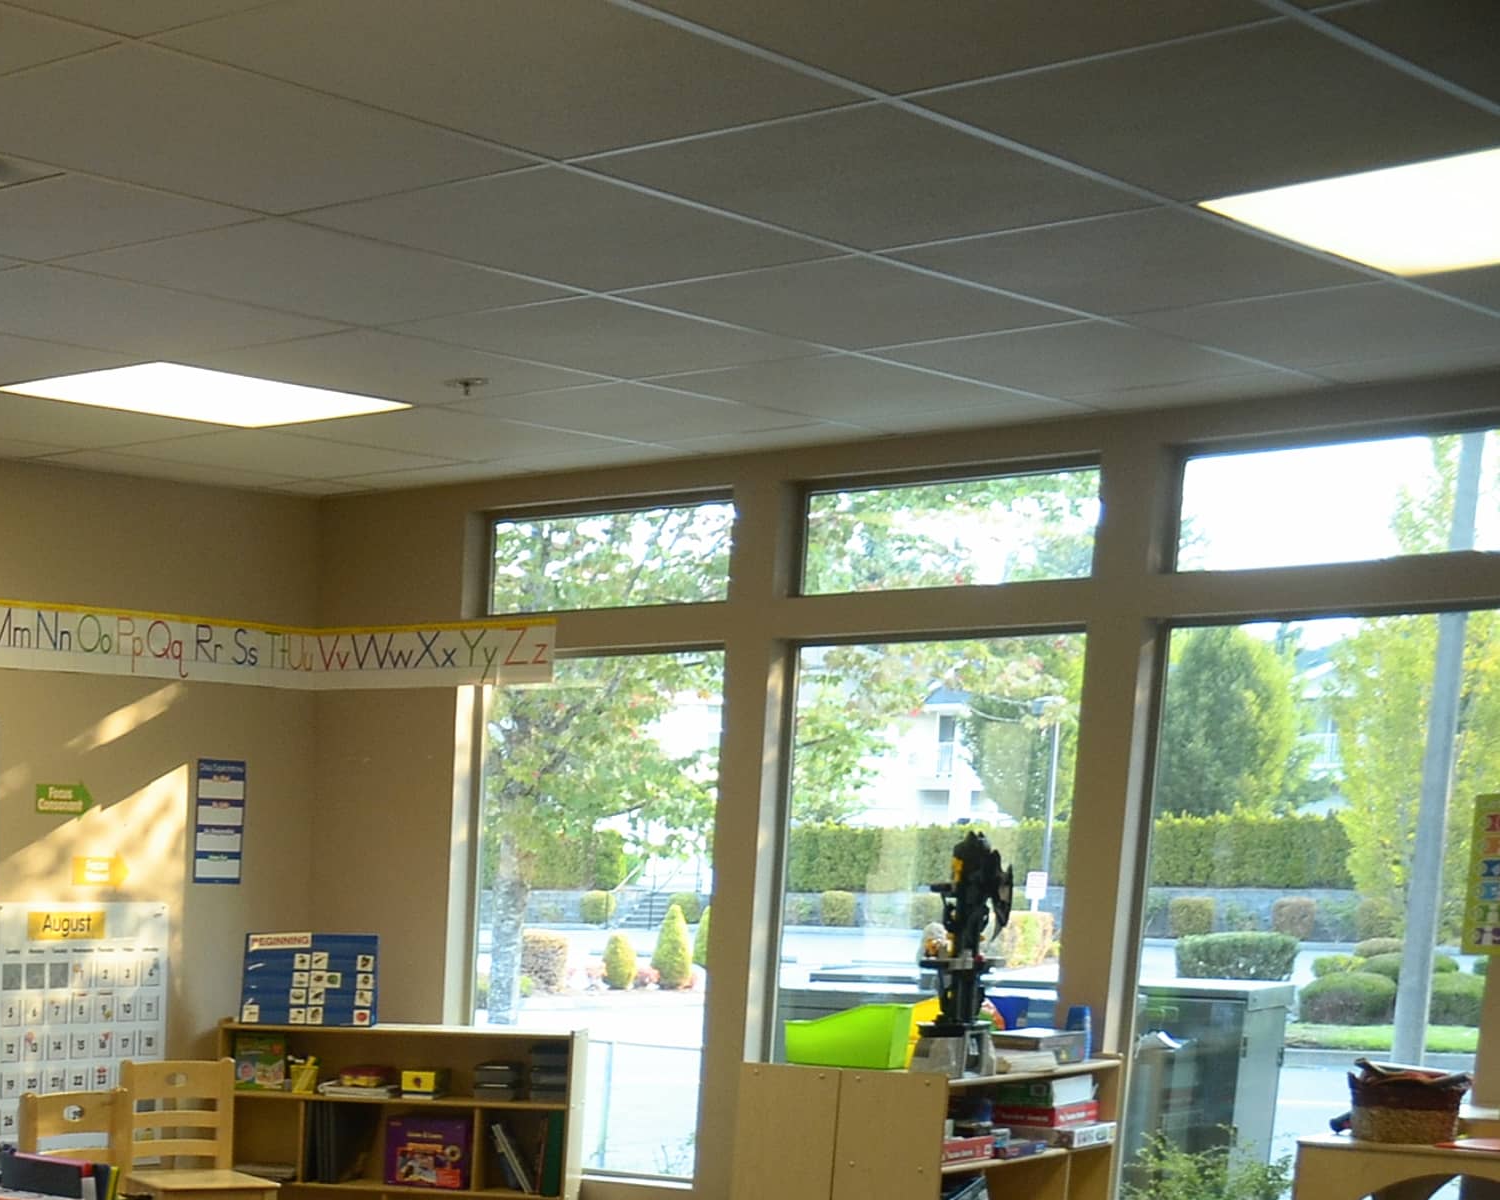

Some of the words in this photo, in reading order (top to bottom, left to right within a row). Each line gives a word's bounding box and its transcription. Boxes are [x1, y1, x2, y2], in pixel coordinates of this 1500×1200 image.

[36, 610, 72, 651] Nn
[77, 613, 111, 655] Oo
[117, 616, 142, 673] Pp
[147, 620, 188, 678] Qq
[196, 625, 222, 662] Rr
[232, 629, 258, 666] Ss
[317, 635, 350, 670] Vv
[351, 633, 414, 670] Ww
[415, 631, 457, 668] Xx
[460, 630, 498, 681] Yy
[505, 627, 548, 665] Zz
[42, 914, 92, 937] August
[123, 1003, 133, 1015] 10
[6, 1043, 15, 1055] 12
[53, 1040, 62, 1052] 14
[77, 1039, 86, 1051] 15
[122, 1037, 130, 1049] 17
[146, 1036, 154, 1048] 18
[6, 1078, 15, 1091] 19
[74, 1074, 84, 1087] 22
